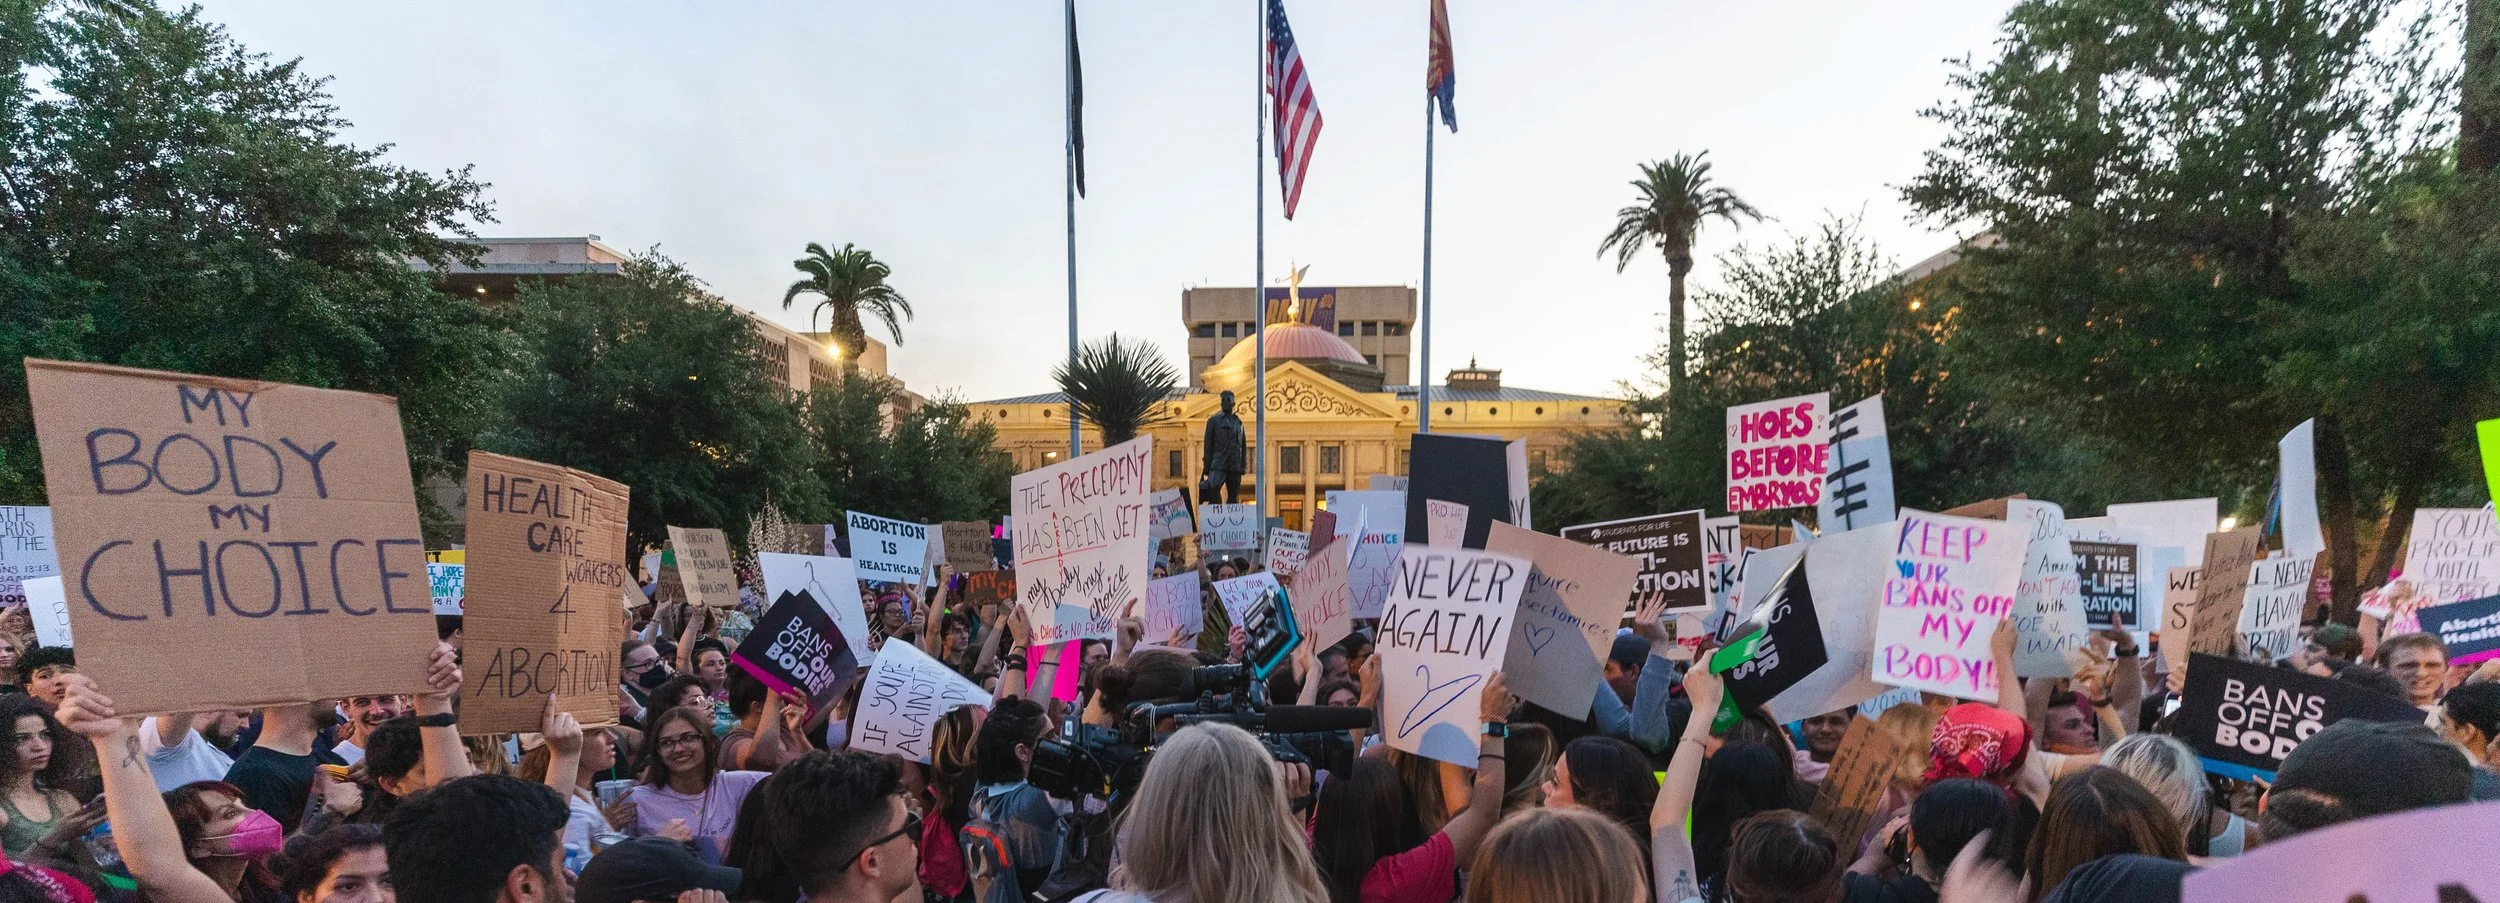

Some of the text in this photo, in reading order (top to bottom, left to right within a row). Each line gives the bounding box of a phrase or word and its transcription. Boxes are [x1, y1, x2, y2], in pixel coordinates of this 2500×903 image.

[177, 384, 254, 427] MY
[1740, 402, 1815, 443] HOES
[85, 427, 338, 499] BODY
[1731, 443, 1830, 480] BEFORE
[1019, 445, 1149, 516] THE PRECEDENT
[1729, 477, 1822, 511] EMBRYOS
[208, 504, 271, 533] MY
[482, 473, 592, 527] HEALTH
[12, 536, 47, 551] THE
[527, 521, 584, 558] CARE
[850, 514, 926, 540] ABORTION
[1018, 522, 1053, 560] HAS
[1062, 506, 1106, 551] BEEN
[1113, 504, 1143, 541] SET
[1203, 531, 1217, 546] MY
[1609, 535, 1669, 553] FUTURE
[1673, 532, 1689, 547] IS
[1706, 524, 1739, 553] NT
[1897, 516, 1988, 563] KEEP
[881, 540, 897, 555] IS
[1632, 551, 1667, 571] TI-
[2094, 554, 2129, 572] THE
[80, 539, 431, 621] CHOICE
[442, 565, 465, 577] HOPE
[565, 559, 624, 587] WORKERS
[1389, 554, 1514, 606] NEVER
[1528, 572, 1580, 594] quire
[1896, 559, 1949, 586] YOUR
[2082, 572, 2135, 594] -LIFE
[549, 586, 576, 633] 4
[1885, 577, 1965, 613] BANS
[2080, 595, 2133, 613] RATION
[786, 616, 833, 659] BANS
[1377, 608, 1502, 661] AGAIN
[1919, 611, 1975, 649] MY
[476, 647, 613, 698] ABORTION
[764, 642, 824, 697] BODIES
[777, 630, 815, 660] OFF
[810, 655, 836, 688] OUR
[896, 673, 937, 757] AGAINST
[2217, 702, 2292, 735] OFF
[2223, 678, 2326, 722] BANS
[863, 720, 889, 747] IF
